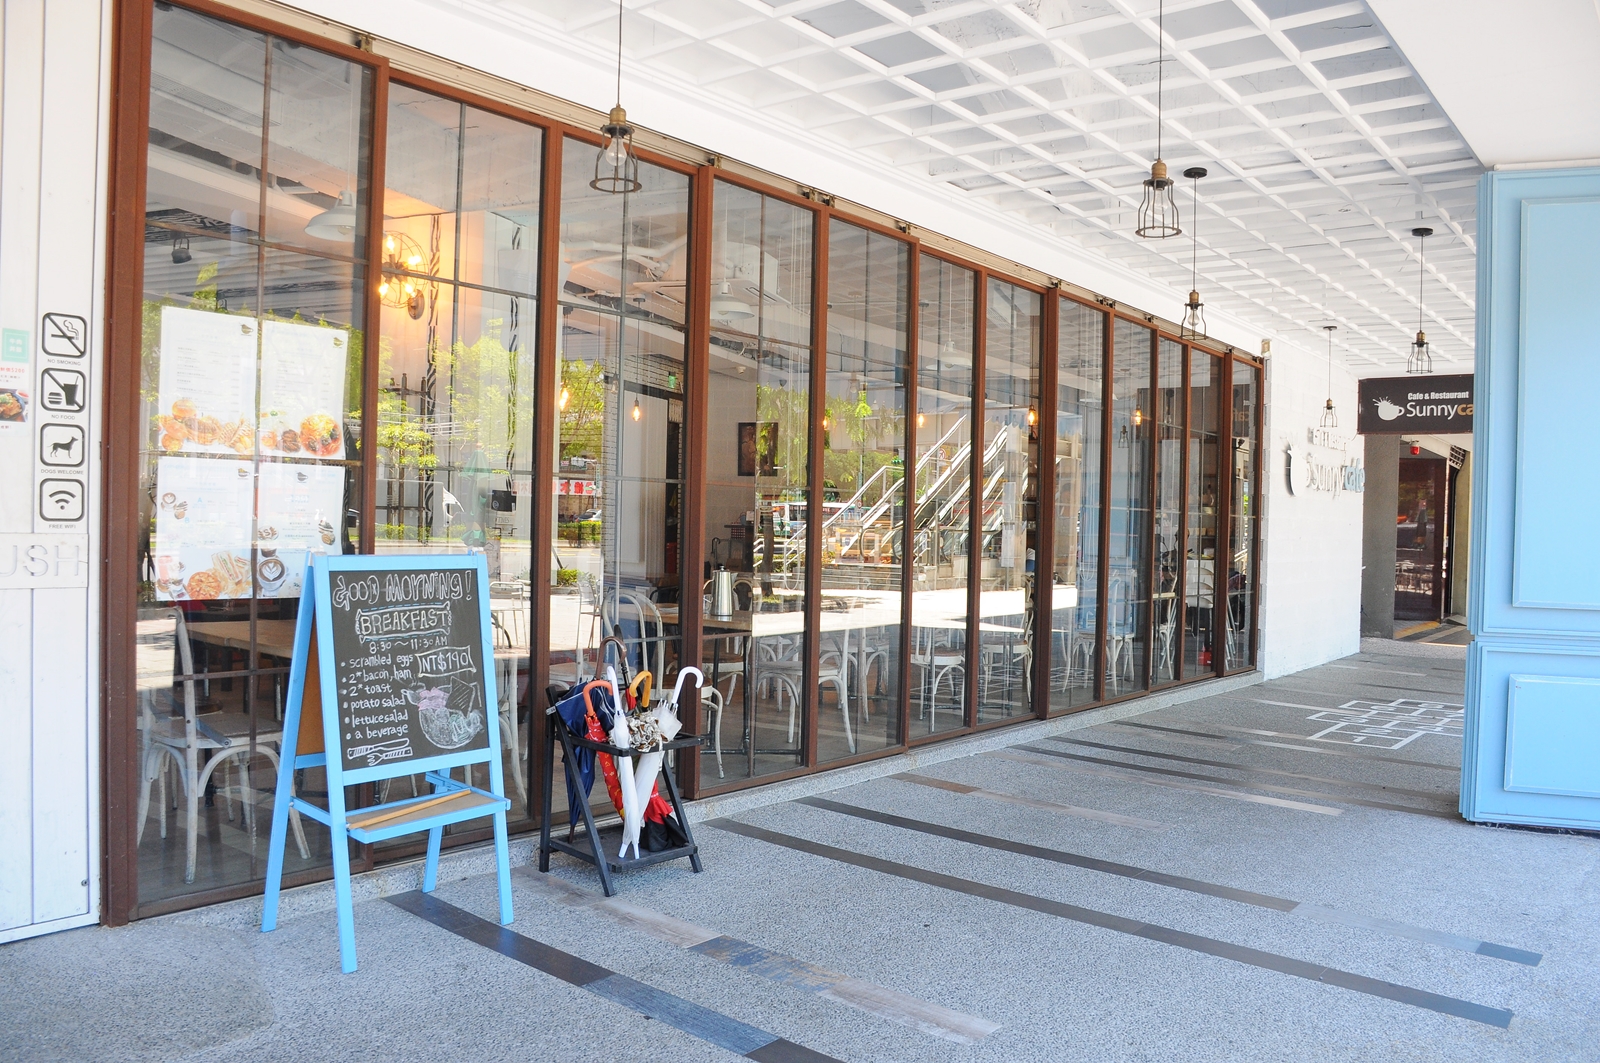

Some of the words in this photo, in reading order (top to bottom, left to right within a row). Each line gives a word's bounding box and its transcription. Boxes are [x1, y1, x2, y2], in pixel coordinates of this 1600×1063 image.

[1430, 391, 1469, 399] Restaurant
[361, 609, 448, 635] BREAKFAST
[435, 636, 448, 646] AM
[349, 654, 391, 668] scrambled
[396, 654, 413, 667] eggs
[422, 651, 468, 672] NT$190
[351, 698, 380, 713] potato
[382, 693, 406, 708] salad
[355, 731, 363, 739] a
[366, 724, 408, 739] beverage
